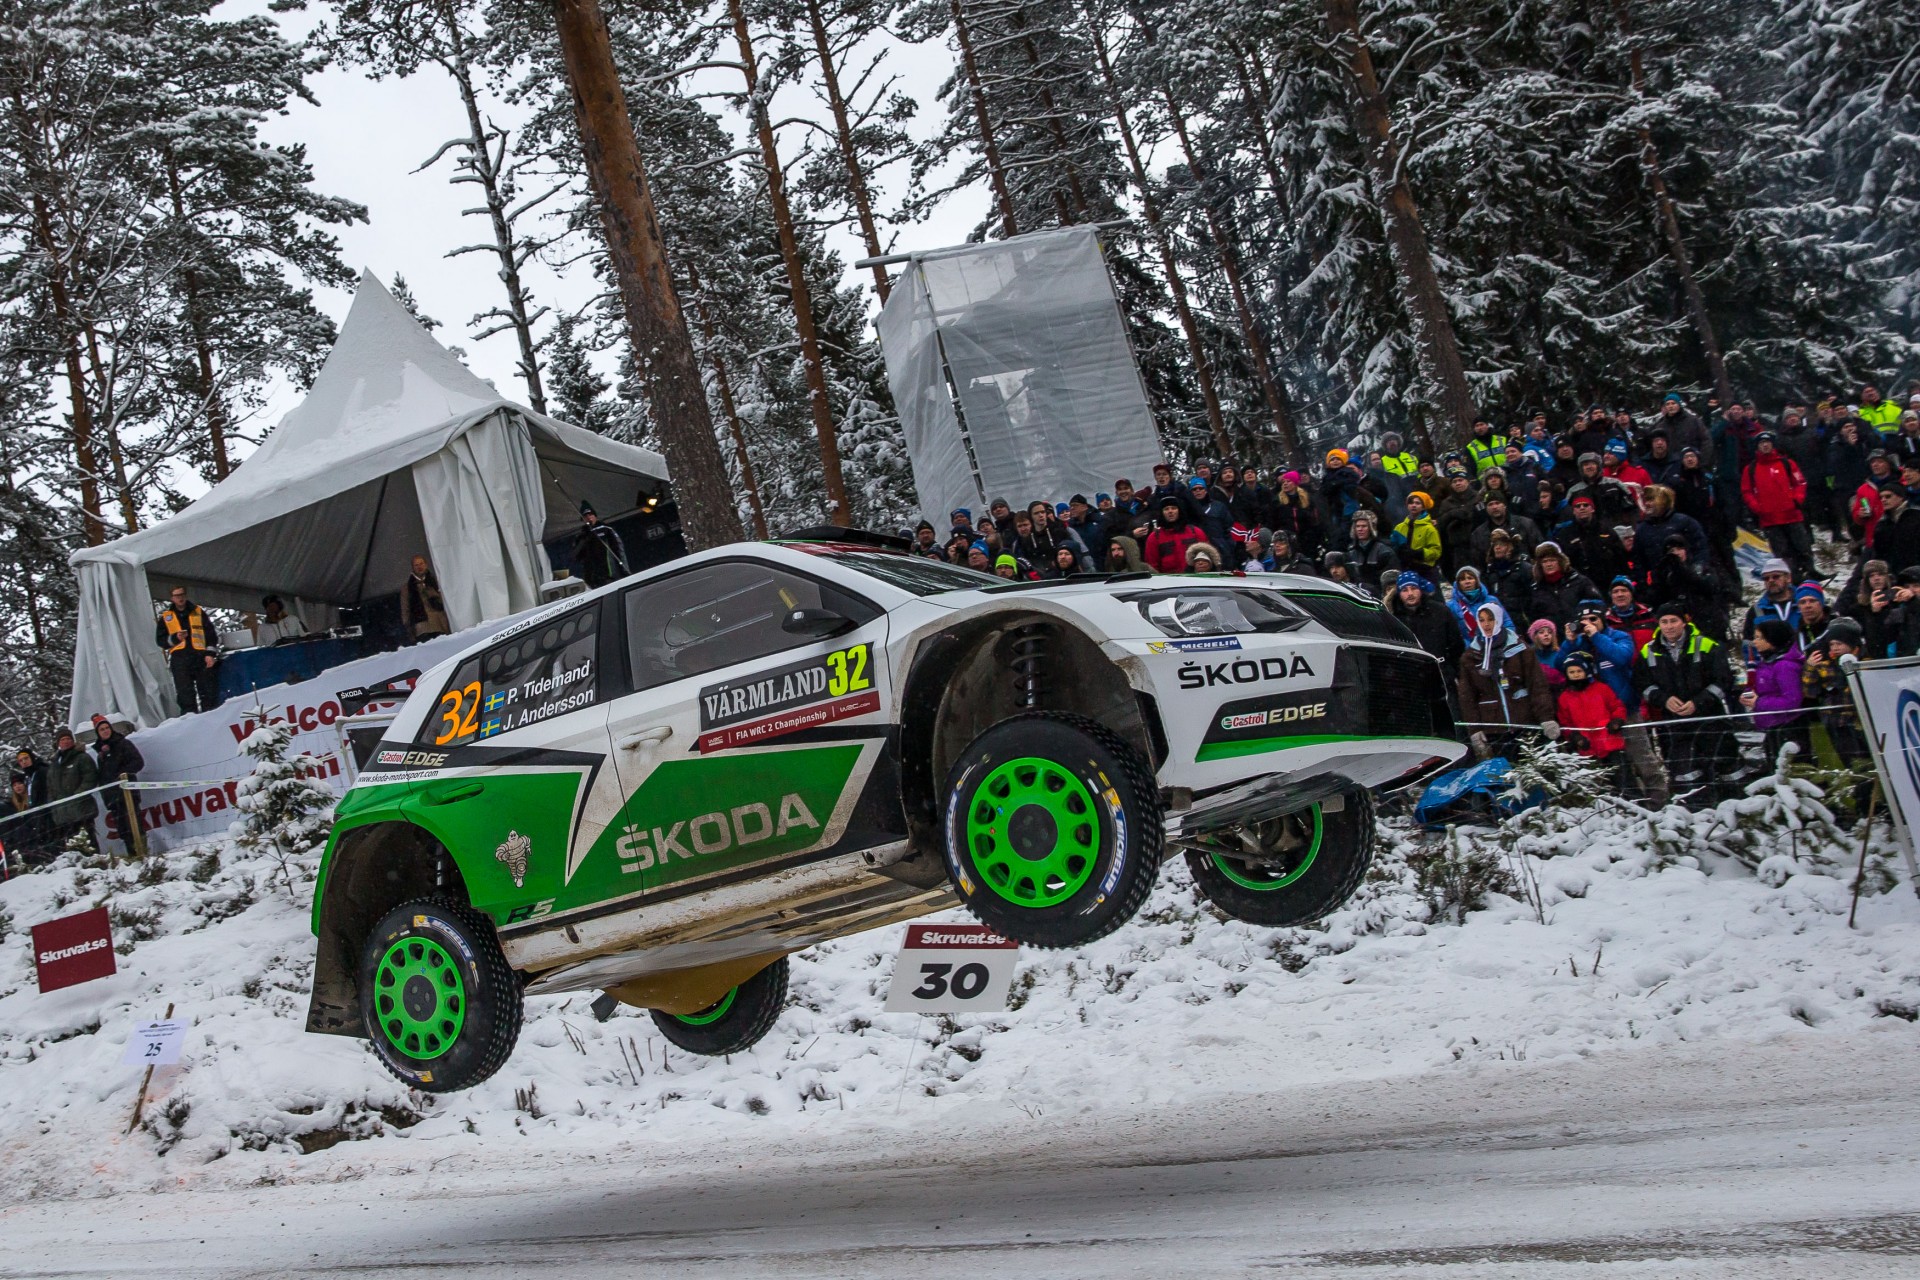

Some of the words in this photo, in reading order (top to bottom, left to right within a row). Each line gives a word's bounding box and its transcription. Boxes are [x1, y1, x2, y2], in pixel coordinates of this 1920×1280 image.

[533, 606, 563, 624] Genuine
[565, 598, 585, 610] Parts
[1181, 639, 1238, 649] MICHELIN
[507, 687, 518, 705] P.
[524, 660, 590, 699] Tidemand
[704, 666, 826, 721] VÄRMLAND
[827, 644, 869, 697] 32
[1177, 654, 1315, 690] ŠKODA
[435, 681, 481, 746] 32
[502, 714, 514, 731] J.
[518, 689, 594, 727] Andersson
[1233, 713, 1264, 728] Castrol
[1268, 702, 1327, 724] EDGE
[736, 730, 748, 741] FIA
[749, 726, 766, 737] WRC
[768, 723, 773, 732] 2
[775, 710, 827, 731] Championship
[403, 751, 450, 767] EDGE
[615, 792, 820, 875] ŠKODA
[506, 898, 556, 925] R5
[39, 937, 108, 964] Skruvat.se
[920, 931, 1006, 945] Skruvat.se
[911, 962, 990, 1000] 30
[144, 1042, 163, 1057] 25
